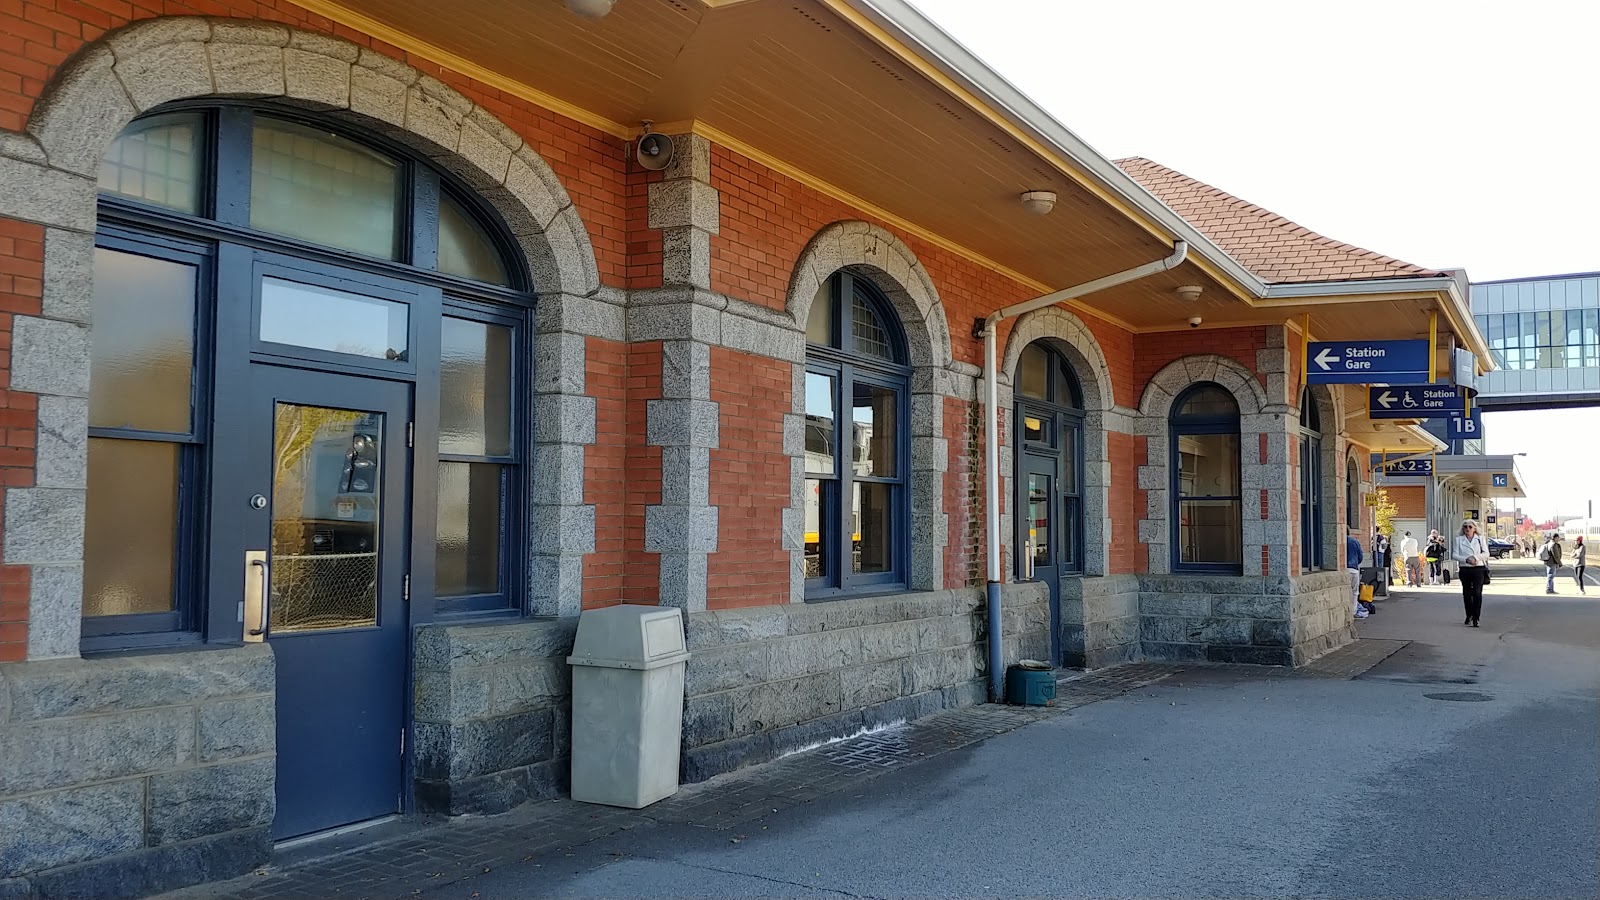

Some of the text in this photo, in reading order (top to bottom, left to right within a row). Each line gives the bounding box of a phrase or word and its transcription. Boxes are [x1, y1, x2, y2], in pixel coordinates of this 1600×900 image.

[1345, 347, 1386, 358] Station
[1345, 360, 1372, 369] Gare
[1423, 390, 1455, 398] Station
[1423, 399, 1444, 407] Gare
[1452, 417, 1476, 433] 1B
